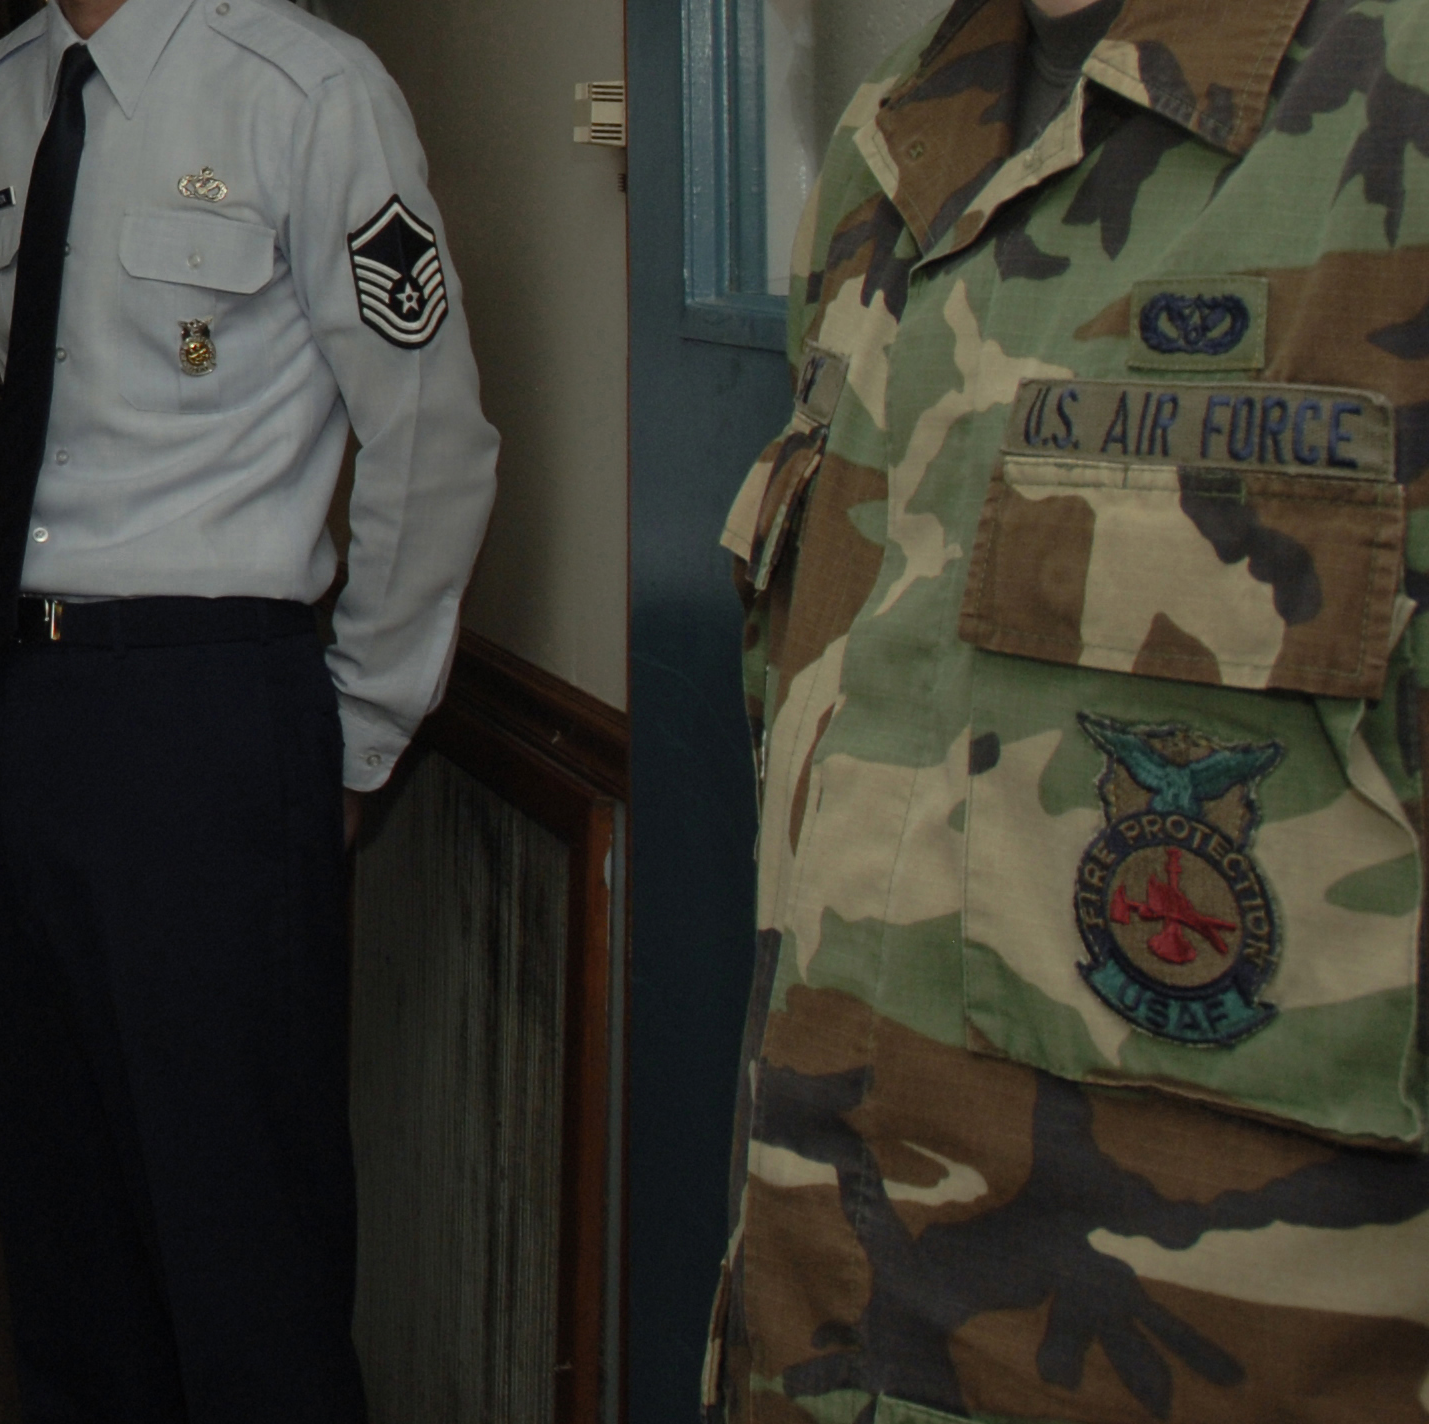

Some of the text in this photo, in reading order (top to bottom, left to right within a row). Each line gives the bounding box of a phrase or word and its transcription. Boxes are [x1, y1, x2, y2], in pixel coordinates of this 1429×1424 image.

[1023, 376, 1362, 469] U.S. AIR FORCE
[1079, 814, 1277, 968] FIRE PROTECTION
[1117, 979, 1229, 1032] USAF
